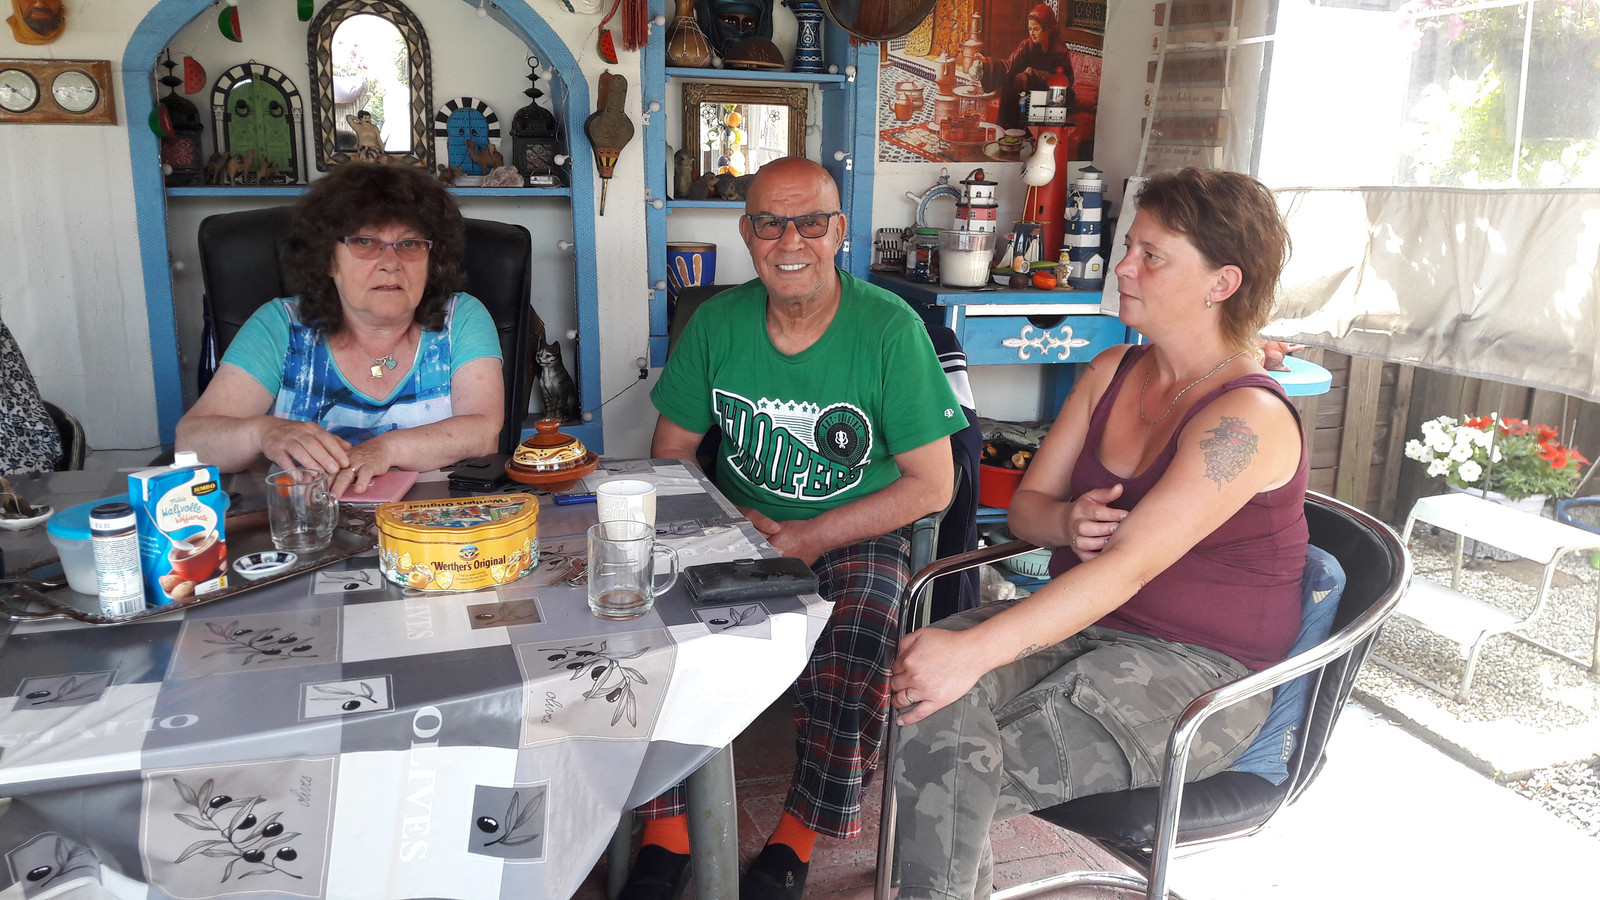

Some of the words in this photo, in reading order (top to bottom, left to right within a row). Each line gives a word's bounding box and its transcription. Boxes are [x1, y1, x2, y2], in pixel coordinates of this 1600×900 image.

[193, 482, 216, 493] JUMBO
[161, 502, 202, 518] Halfvolle
[409, 501, 455, 510] Original
[430, 560, 472, 573] Werther's
[473, 555, 506, 569] Original
[540, 690, 563, 725] olives
[399, 704, 443, 863] OLIVES
